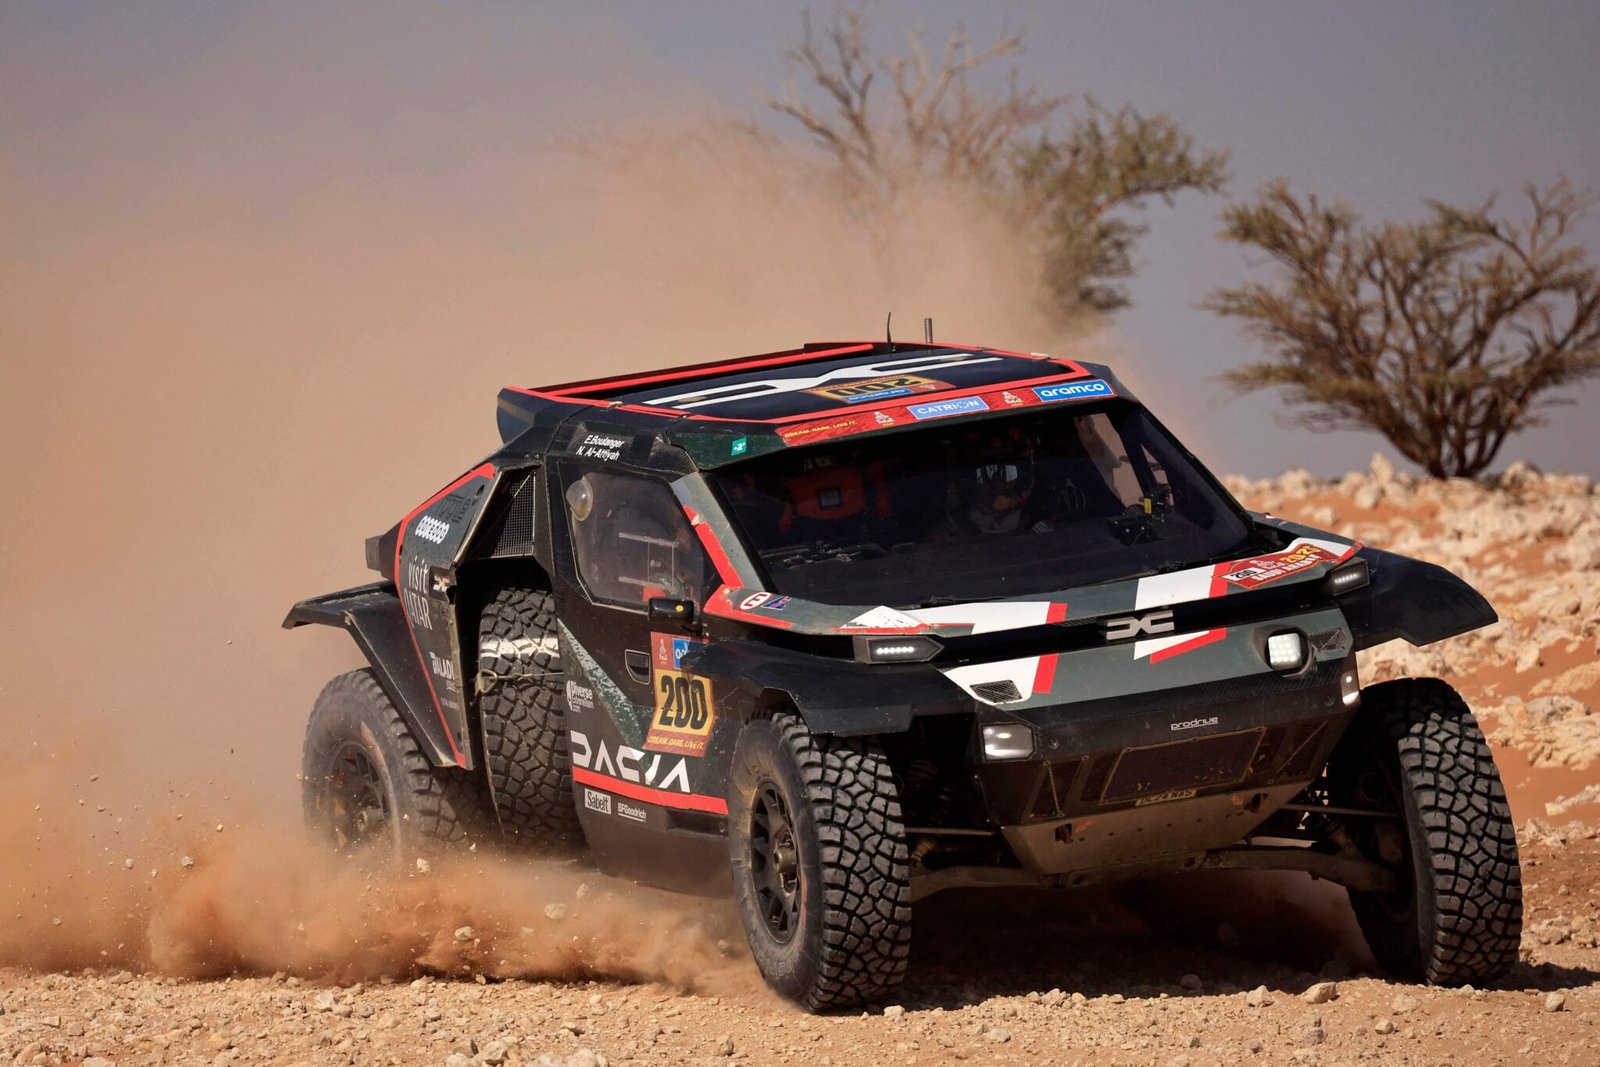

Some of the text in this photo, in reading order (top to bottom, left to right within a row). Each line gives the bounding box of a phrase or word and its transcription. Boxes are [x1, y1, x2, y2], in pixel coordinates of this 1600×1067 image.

[1041, 383, 1105, 397] aramco
[917, 400, 979, 415] CATRION
[584, 447, 620, 461] Al-Attiyah
[408, 555, 429, 594] visit
[1230, 569, 1257, 578] 200
[659, 675, 708, 730] 200
[570, 730, 690, 793] DACIA
[587, 791, 609, 812] Sabelt
[618, 802, 647, 819] BFGoodrich
